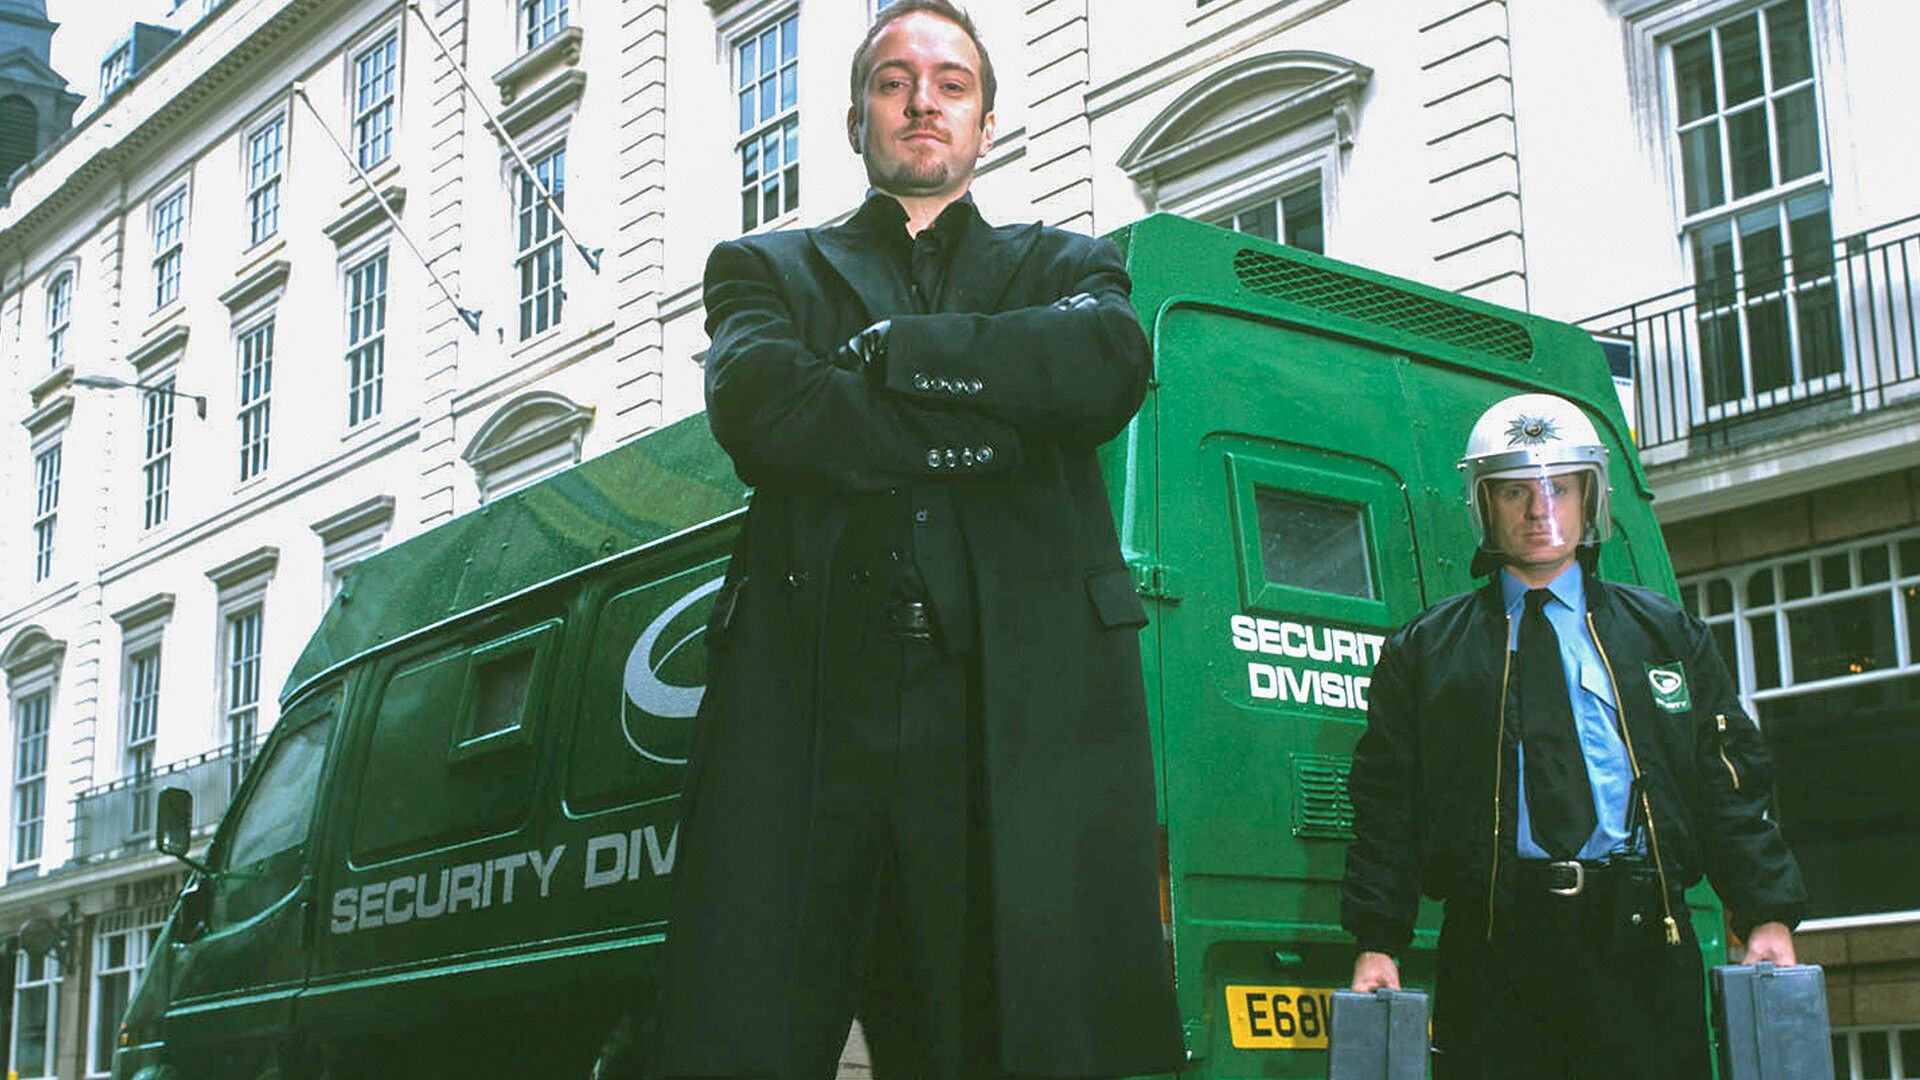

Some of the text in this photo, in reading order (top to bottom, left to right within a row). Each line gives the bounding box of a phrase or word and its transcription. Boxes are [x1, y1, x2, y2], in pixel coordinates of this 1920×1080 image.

[1231, 614, 1385, 666] SECURIT
[331, 821, 680, 934] SECURITY DIV
